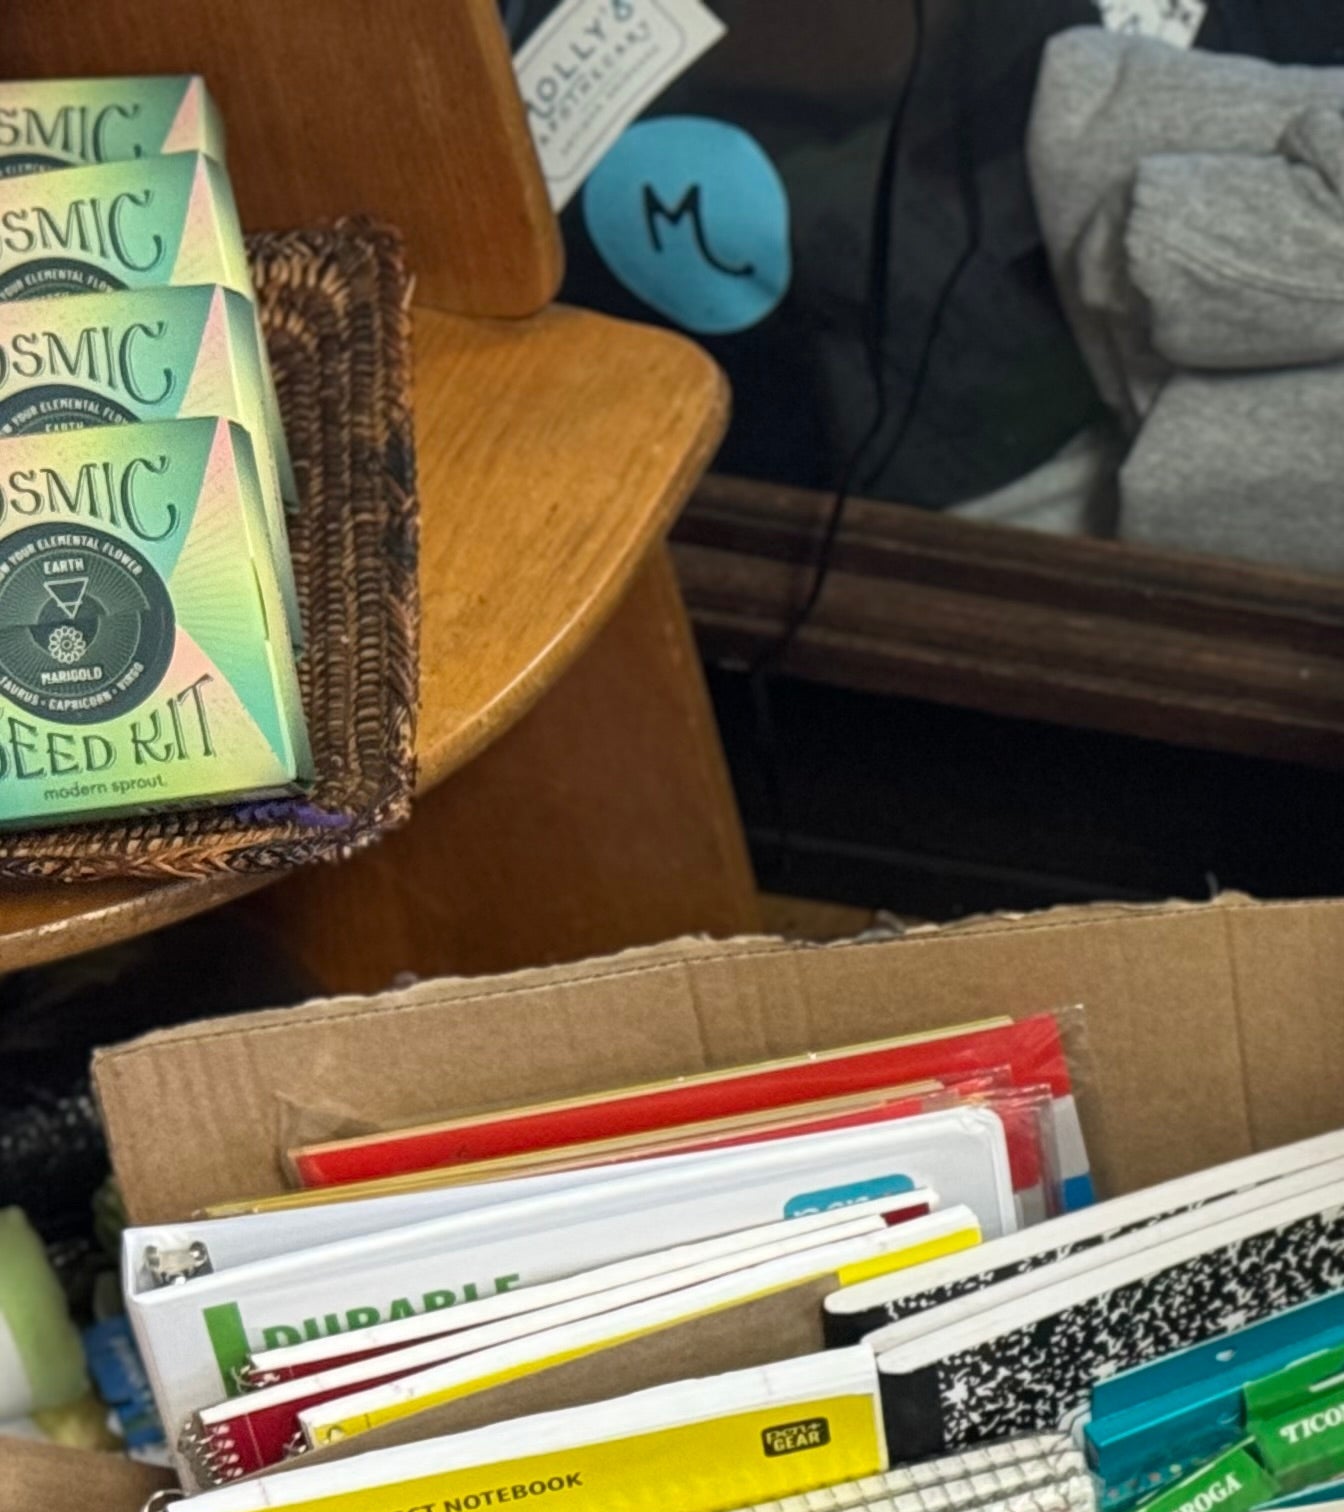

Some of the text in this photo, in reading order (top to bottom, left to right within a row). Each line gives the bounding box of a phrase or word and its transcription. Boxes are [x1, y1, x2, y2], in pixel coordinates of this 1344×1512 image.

[0, 104, 142, 163] SMIC
[0, 189, 166, 273] SMIC
[642, 183, 756, 276] M
[0, 320, 176, 405] SMIC
[0, 455, 181, 542] SMIC
[36, 534, 100, 552] ELEMENTAL
[102, 542, 143, 576] FLOWER
[43, 558, 85, 576] EARTH
[0, 675, 40, 706] TAURUS
[40, 666, 104, 687] MARIGOLD
[130, 672, 218, 766] KIT
[43, 772, 166, 802] modern sprout
[773, 1430, 821, 1453] GEAR
